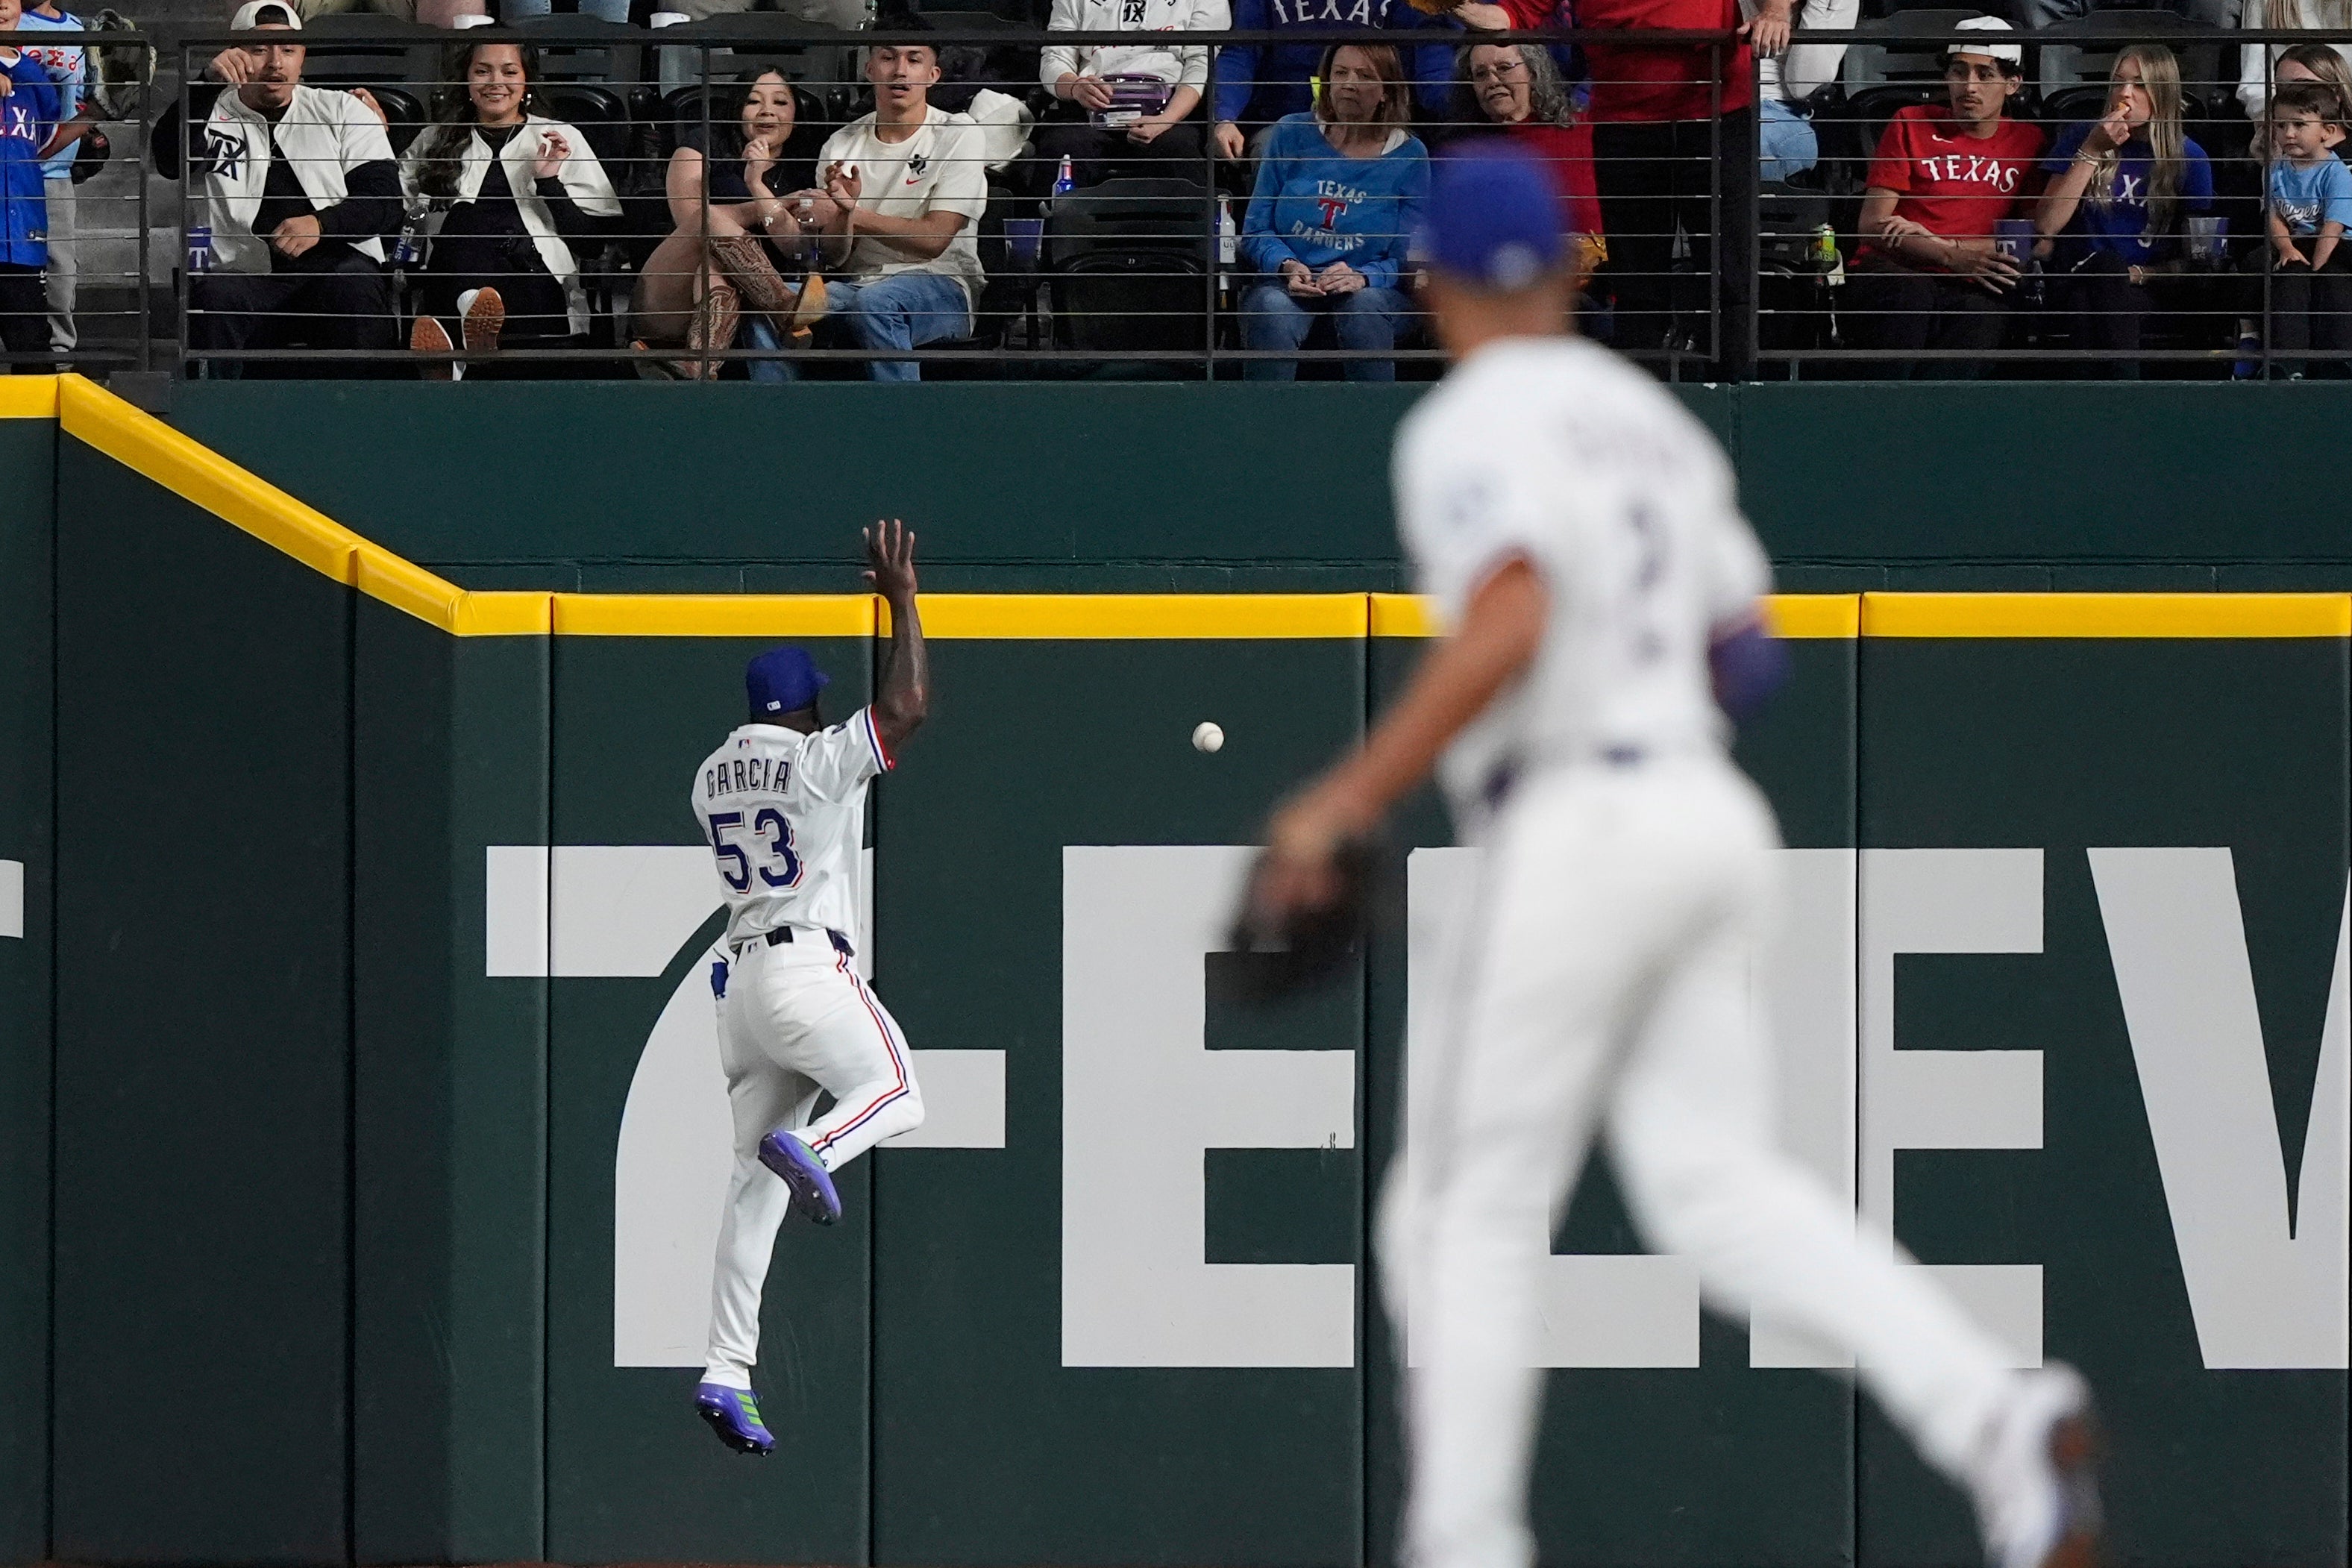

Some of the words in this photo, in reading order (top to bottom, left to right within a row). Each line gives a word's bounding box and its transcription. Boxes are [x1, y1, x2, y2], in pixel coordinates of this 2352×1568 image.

[1317, 180, 1367, 204] TEXAS
[1921, 154, 2020, 193] TEXAS
[188, 246, 209, 269] T
[706, 758, 791, 801] GARCIA
[708, 807, 803, 894] 53
